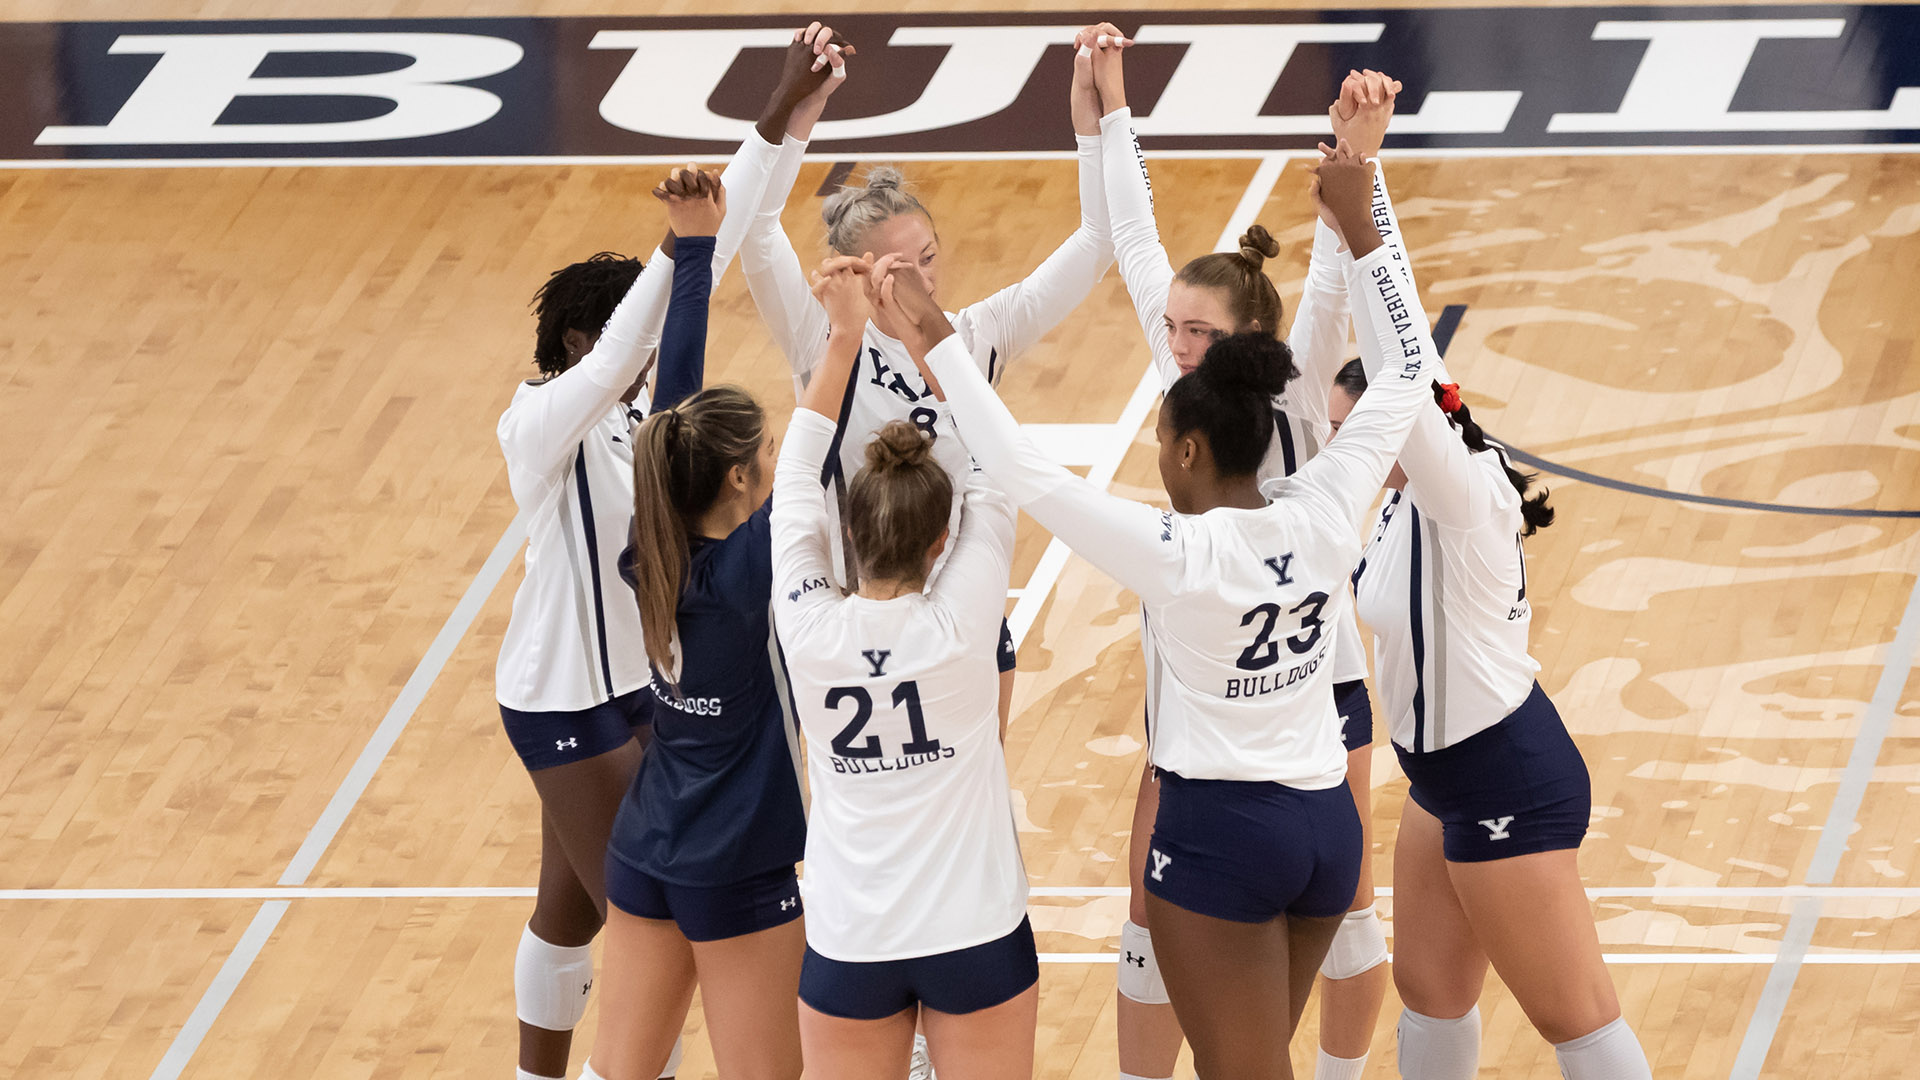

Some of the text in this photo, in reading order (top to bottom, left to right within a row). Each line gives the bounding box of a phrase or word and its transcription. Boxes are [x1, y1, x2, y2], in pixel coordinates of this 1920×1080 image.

[1371, 265, 1412, 335] VERITAS
[1399, 336, 1421, 358] ET
[802, 576, 831, 594] Ivy
[1263, 551, 1294, 587] Y
[1236, 591, 1330, 671] 23
[861, 649, 892, 678] Y
[1225, 646, 1327, 699] BULLDOGS
[824, 680, 941, 759] 21
[1478, 815, 1515, 841] Y
[1151, 848, 1172, 882] Y
